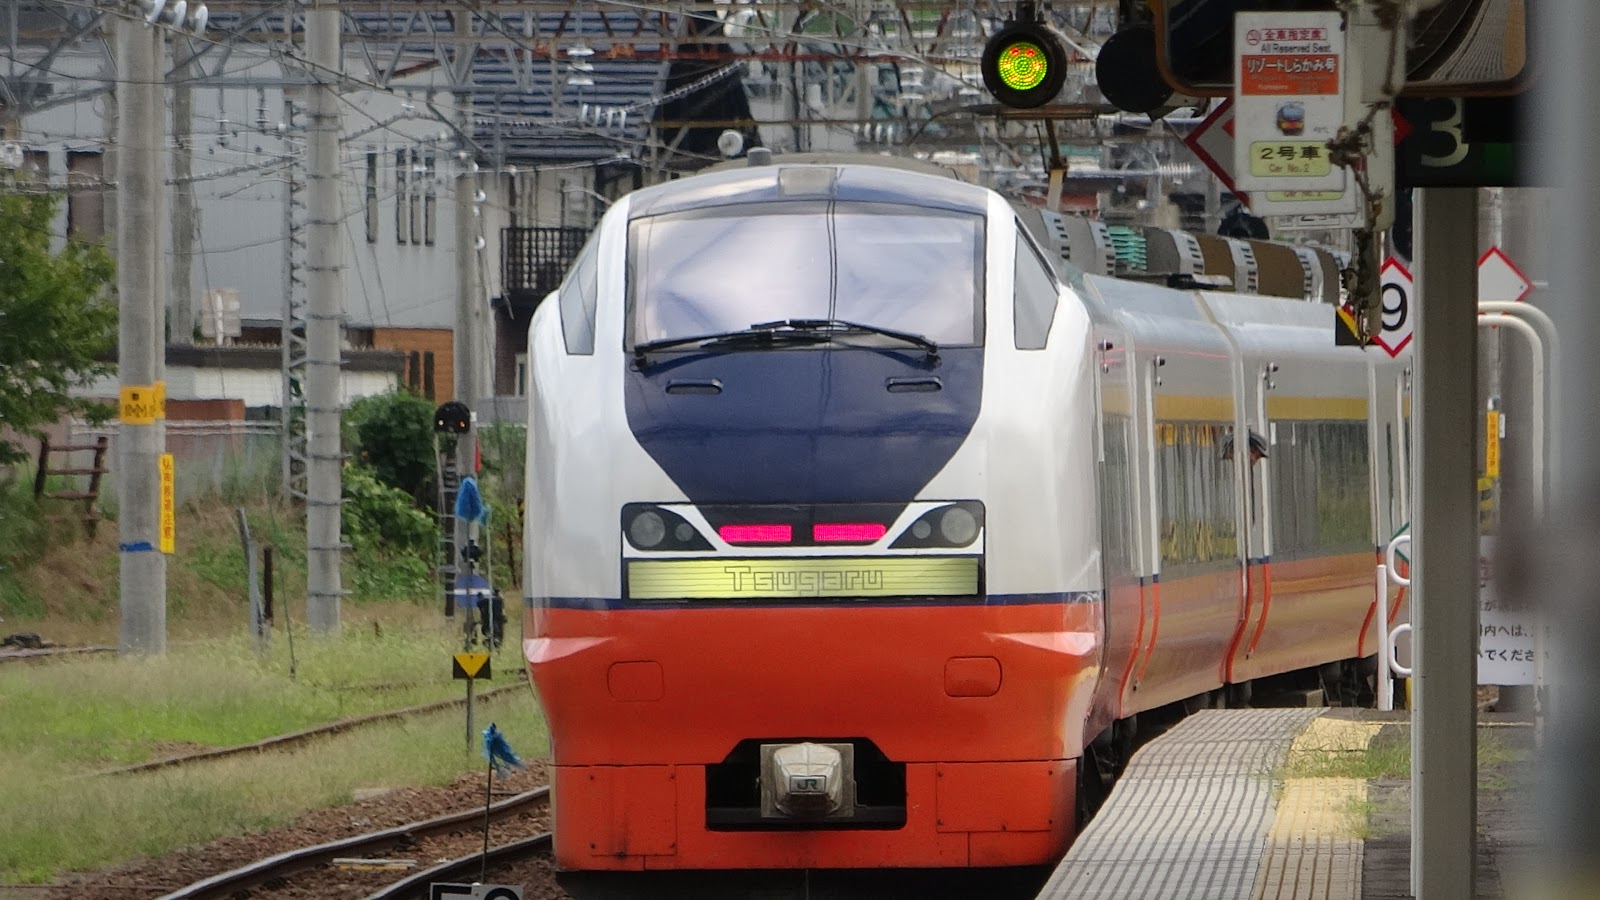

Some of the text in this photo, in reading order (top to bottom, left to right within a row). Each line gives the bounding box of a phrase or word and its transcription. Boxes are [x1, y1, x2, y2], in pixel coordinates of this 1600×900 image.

[1264, 29, 1322, 40] 全車指定席
[1261, 43, 1271, 54] All
[1272, 43, 1310, 54] Reserved
[1247, 57, 1336, 73] リゾートしらかみ号
[1420, 97, 1470, 167] 3
[1260, 146, 1321, 160] 2号車
[1381, 282, 1408, 331] 9
[724, 565, 883, 596] Tsugaru
[797, 779, 817, 790] JR
